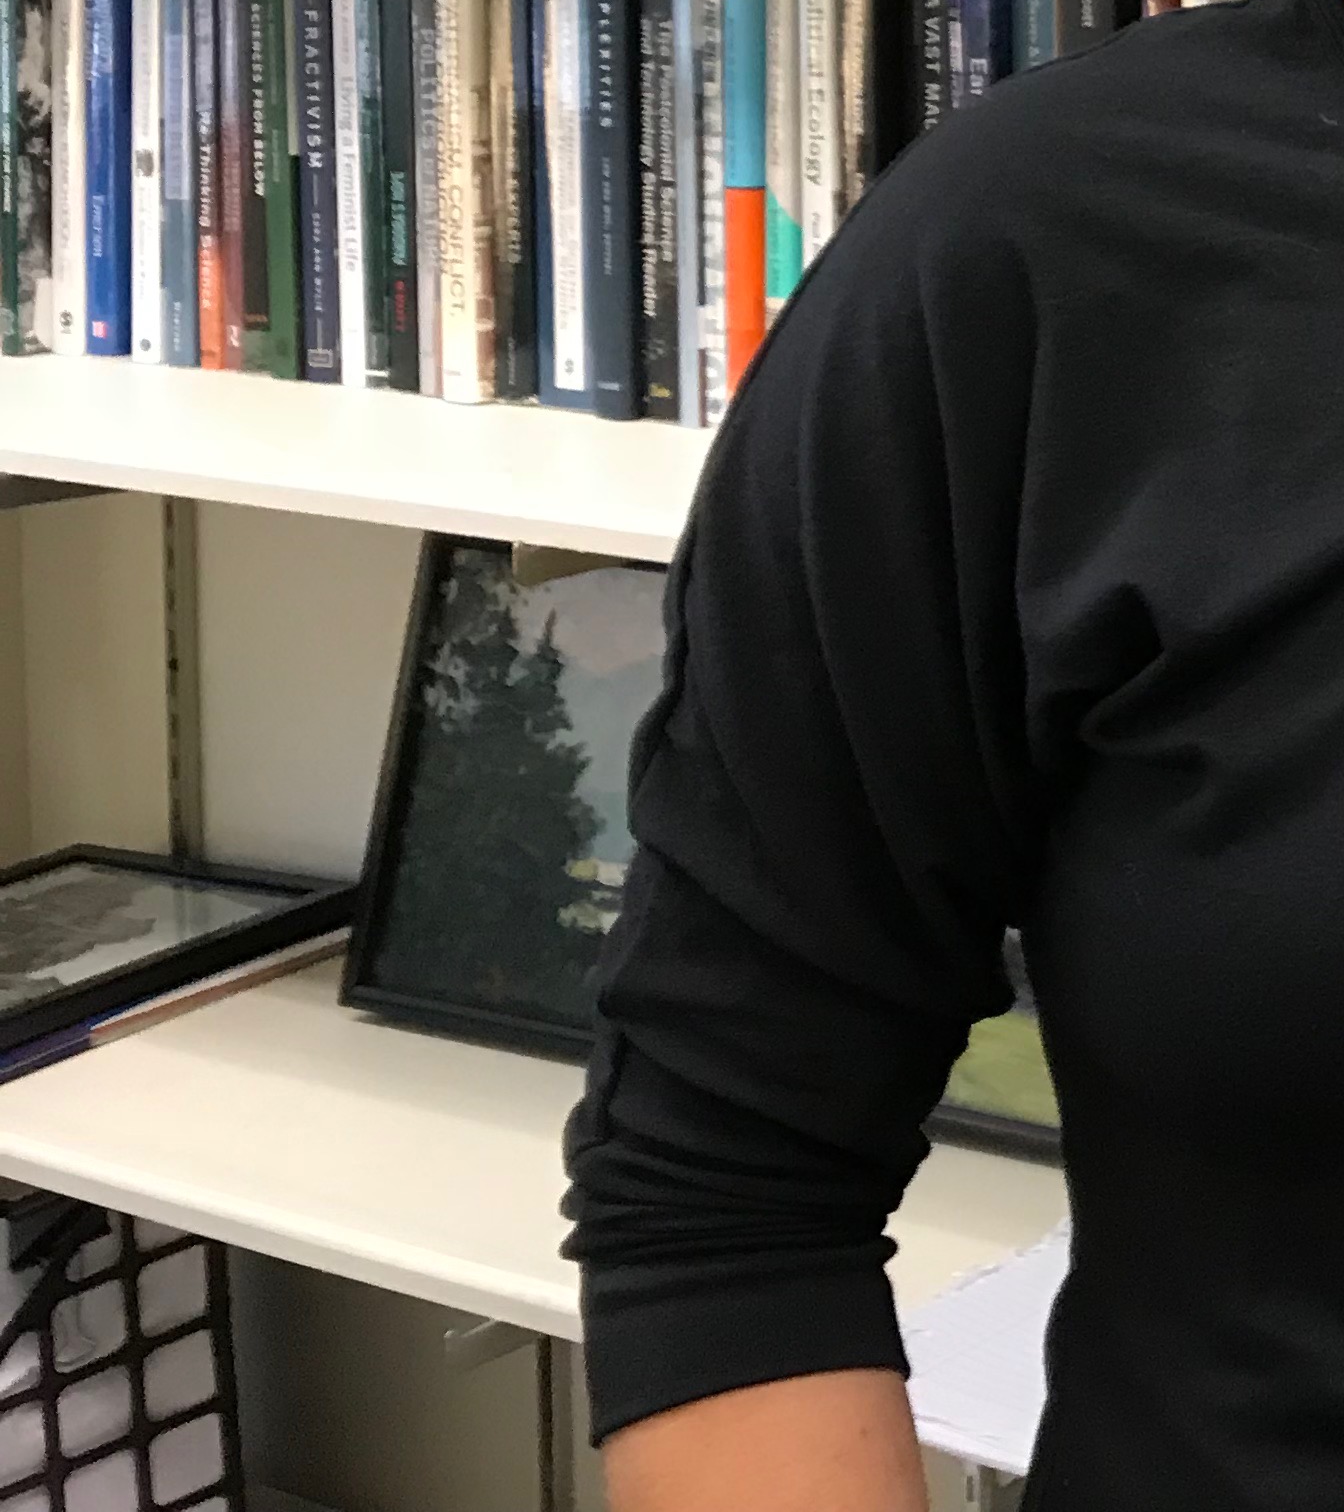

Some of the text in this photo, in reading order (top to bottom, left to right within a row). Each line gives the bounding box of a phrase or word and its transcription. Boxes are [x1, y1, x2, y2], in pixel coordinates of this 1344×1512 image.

[304, 9, 323, 169] FRACTIVISM
[924, 17, 941, 74] VAST
[338, 76, 360, 272] Living a Feminist Life
[805, 88, 826, 186] Ecology
